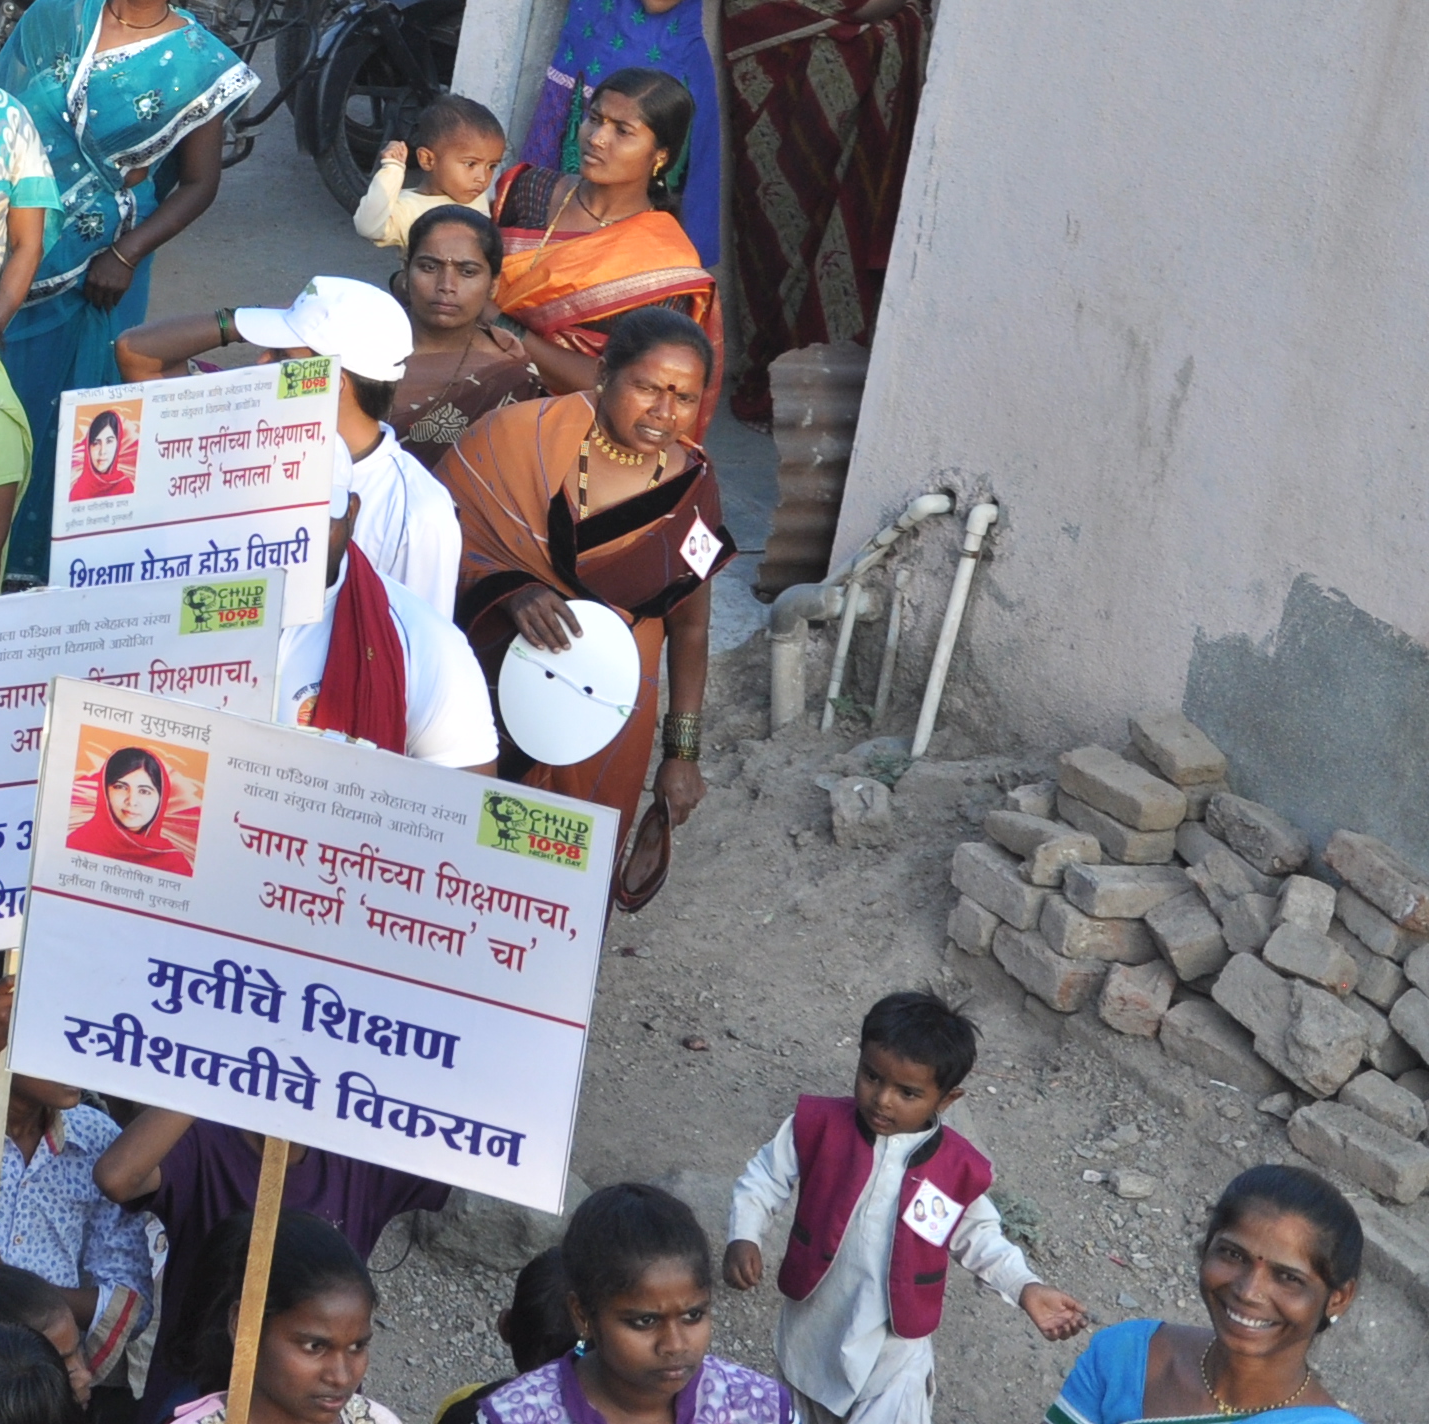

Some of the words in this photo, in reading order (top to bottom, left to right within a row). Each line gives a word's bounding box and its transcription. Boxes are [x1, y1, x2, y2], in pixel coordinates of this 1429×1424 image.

[302, 359, 331, 370] CHILD
[303, 367, 330, 379] LINE
[301, 377, 328, 390] 1098
[155, 433, 193, 460] ‘जागर
[198, 426, 251, 465] मुलींच्या
[256, 419, 326, 450] शिक्षणाचा,
[168, 463, 213, 497] आदर्श
[219, 455, 277, 489] ‘मलाला’
[198, 539, 241, 575] होऊ
[247, 526, 310, 570] विचारी
[217, 585, 265, 600] CHILD
[219, 596, 263, 610] LINE
[65, 620, 91, 636] आणि
[143, 612, 172, 626] संस्था
[218, 608, 259, 623] 1098
[148, 659, 258, 695] शिक्षणाचा,
[83, 701, 134, 725] मलाला
[140, 716, 212, 744] युसुफझाई
[227, 756, 272, 777] मलाला
[333, 781, 365, 799] आणि
[370, 790, 427, 816] स्नेहालय
[431, 804, 467, 826] संस्था
[243, 782, 279, 802] यांच्या
[283, 791, 326, 813] संयुक्त
[331, 801, 383, 828] विद्यमाने
[387, 819, 444, 843] आयोजित
[529, 809, 589, 834] CHILD
[528, 834, 581, 860] 1098
[530, 820, 586, 846] LINE
[58, 872, 96, 890] मुलींच्या
[100, 880, 144, 901] शिक्षणाची
[71, 856, 98, 873] नोबेल
[103, 864, 153, 885] पारितोषिक
[157, 878, 182, 892] प्राप्त
[234, 811, 308, 866] ‘जागर
[317, 842, 425, 895] मुलींच्या
[436, 861, 577, 942] शिक्षणाचा,
[259, 881, 346, 926] आदर्श
[360, 894, 478, 957] ‘मलाला’
[488, 936, 538, 973] चा’
[147, 957, 287, 1025] मुलींचे
[302, 983, 460, 1069] शिक्षण
[63, 1012, 321, 1111] स्त्रीशक्तीचे
[337, 1070, 526, 1168] विकसन
